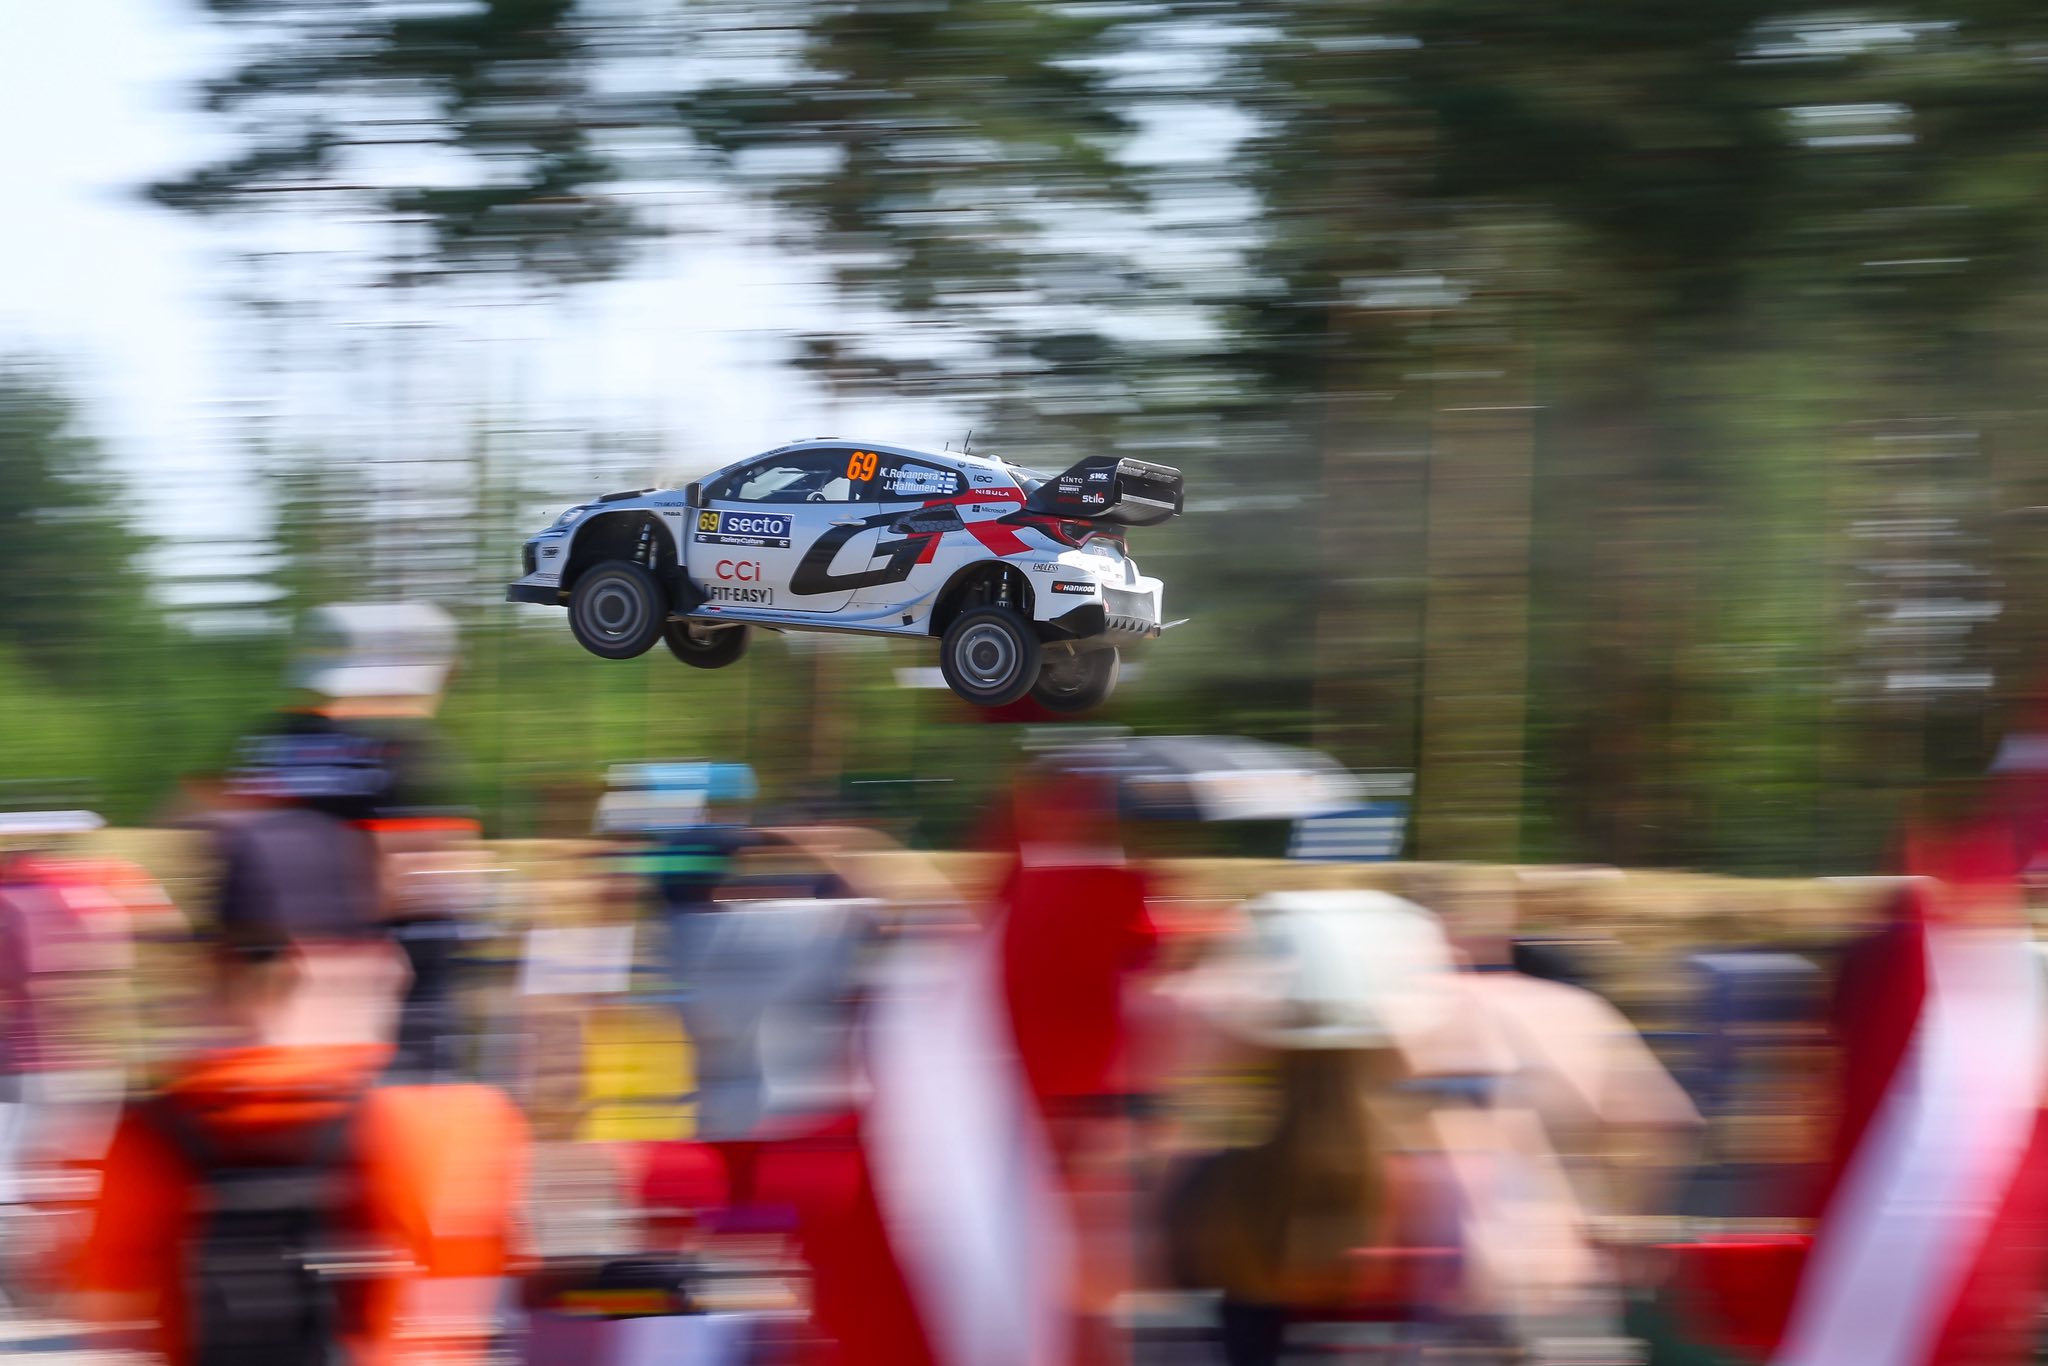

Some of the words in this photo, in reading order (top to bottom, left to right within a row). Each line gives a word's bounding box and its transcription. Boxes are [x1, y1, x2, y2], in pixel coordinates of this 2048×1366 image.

[847, 451, 879, 482] 69
[975, 489, 1010, 497] NISULA
[1082, 493, 1105, 504] Stilo
[981, 506, 1007, 514] Microsoft
[699, 512, 719, 531] 69
[727, 517, 784, 534] secto
[716, 560, 761, 582] CCi
